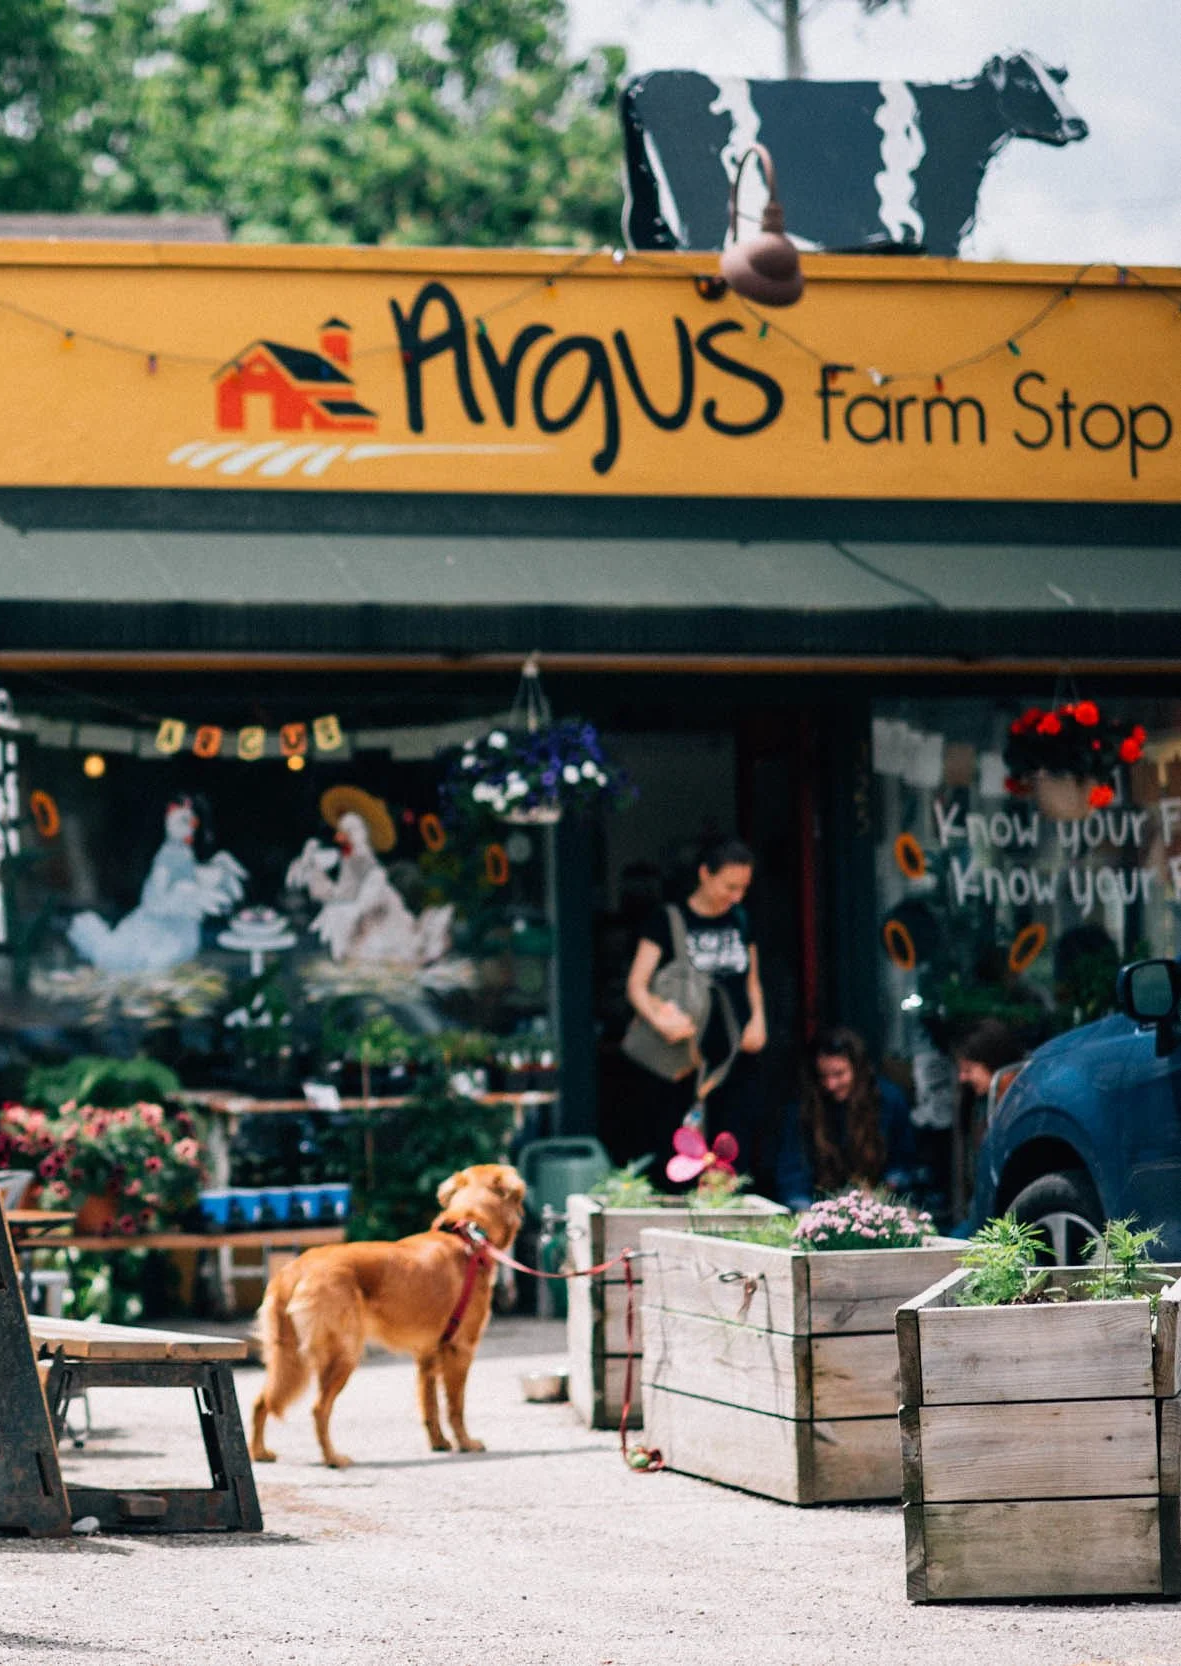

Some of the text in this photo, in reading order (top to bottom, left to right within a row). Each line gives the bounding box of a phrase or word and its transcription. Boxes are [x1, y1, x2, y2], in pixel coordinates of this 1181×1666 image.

[389, 280, 1173, 479] Argus Farm Stop
[933, 799, 1040, 849] Know
[1056, 808, 1150, 857] your
[950, 858, 1059, 906] Know
[1070, 864, 1158, 918] your
